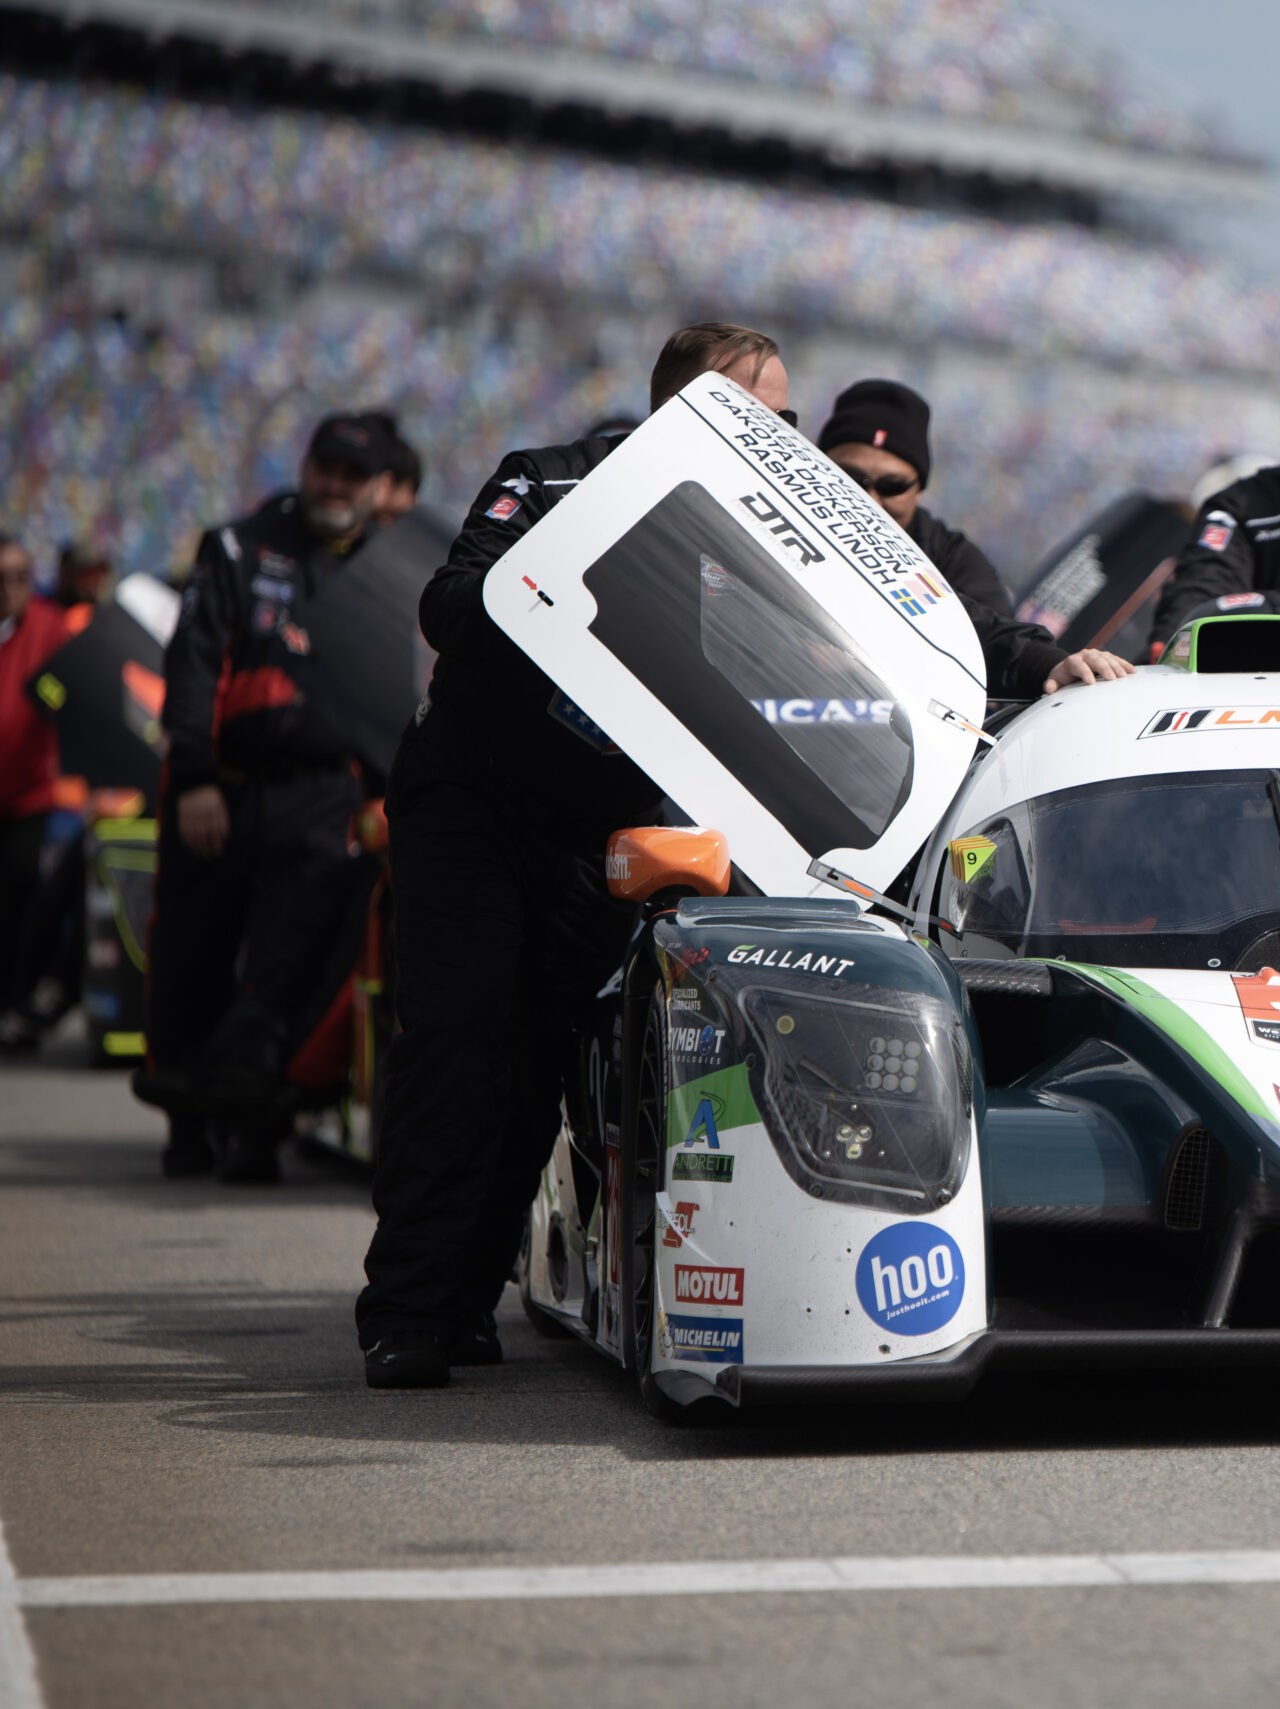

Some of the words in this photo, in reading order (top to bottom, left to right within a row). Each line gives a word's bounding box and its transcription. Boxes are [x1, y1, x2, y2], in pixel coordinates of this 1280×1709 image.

[708, 391, 794, 463] DAKOTA
[794, 468, 909, 574] DICKERSON
[734, 433, 834, 519] RASMUS
[827, 522, 897, 585] LINDH
[828, 482, 916, 566] CHAVES
[739, 491, 826, 567] DTR
[966, 851, 978, 866] 9
[727, 946, 856, 976] GALLANT
[673, 1154, 734, 1172] ANDRETTI
[677, 1270, 740, 1300] MOTUL
[871, 1244, 954, 1312] hoo
[887, 1290, 950, 1321] justhooit.com
[674, 1328, 741, 1348] MICHELIN
